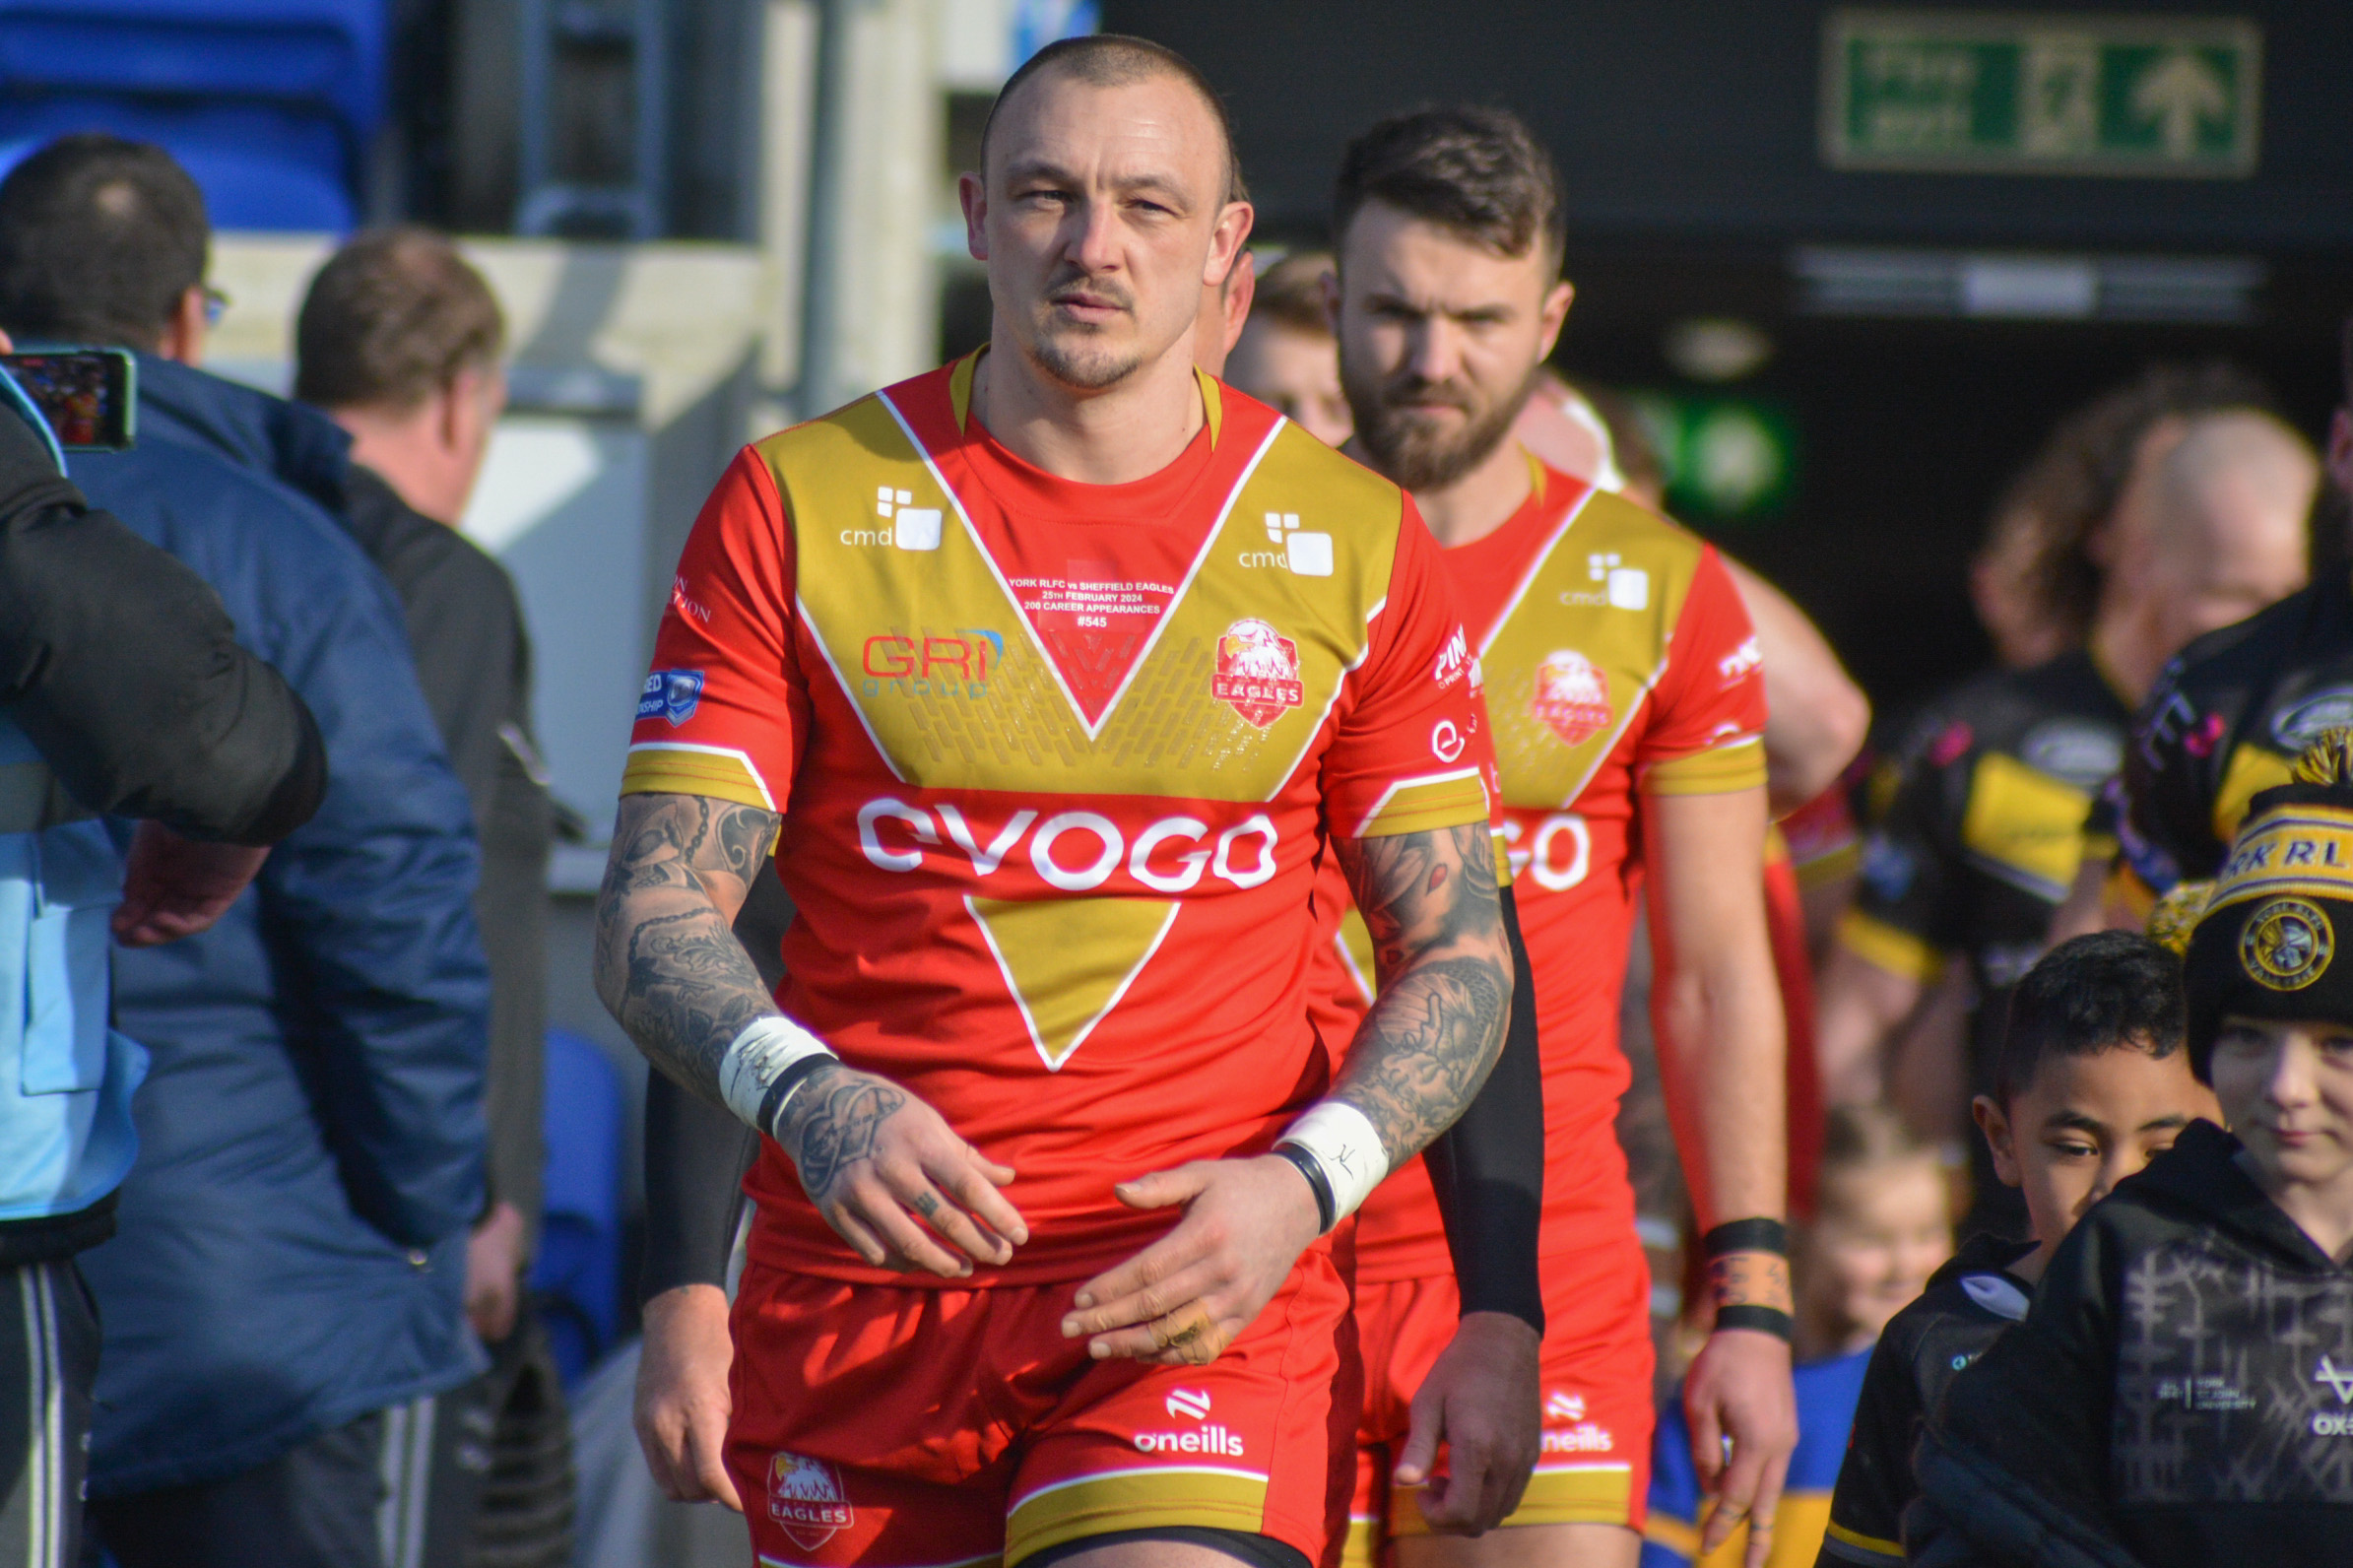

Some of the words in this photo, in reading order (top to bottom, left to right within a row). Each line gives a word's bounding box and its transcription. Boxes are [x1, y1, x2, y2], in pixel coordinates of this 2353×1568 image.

[840, 527, 892, 546] cmd
[1238, 551, 1288, 570] cmd
[1009, 578, 1037, 588] YORK
[1039, 579, 1066, 589] RLFC
[1079, 582, 1133, 592] SHEFFIELD
[1135, 583, 1175, 595] EAGLES
[1042, 591, 1064, 600] 25TH
[1066, 591, 1118, 603] FEBRUARY
[1121, 593, 1143, 603] 2024
[1559, 591, 1607, 607] cmd
[1023, 601, 1041, 610] 200
[1043, 602, 1084, 613] CAREER
[1085, 604, 1160, 615] APPEARANCES
[1077, 616, 1107, 628] #545
[862, 634, 987, 682] GRI
[862, 679, 987, 701] group
[1216, 683, 1300, 702] EAGLES
[771, 1503, 848, 1525] EAGLES
